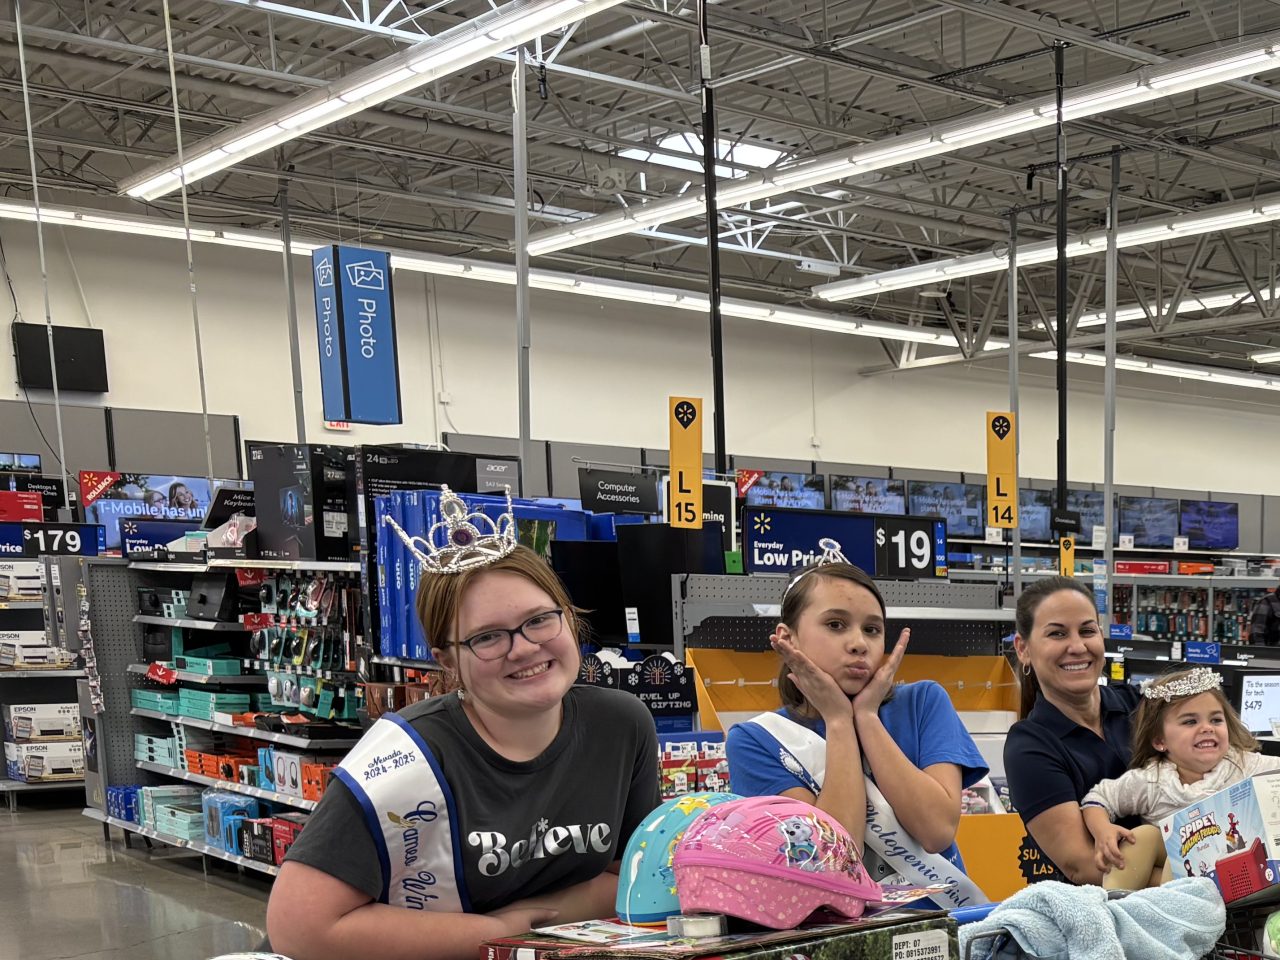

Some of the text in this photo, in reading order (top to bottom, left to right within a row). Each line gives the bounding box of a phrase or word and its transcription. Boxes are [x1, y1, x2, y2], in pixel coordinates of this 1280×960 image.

[322, 297, 332, 357] Photo
[358, 298, 377, 359] Photo
[366, 453, 379, 464] 24
[486, 463, 508, 473] acer
[86, 475, 114, 501] ROLLBACK
[598, 480, 636, 493] Computer
[678, 470, 691, 494] L
[995, 477, 1008, 497] L
[597, 491, 640, 504] Accessories
[98, 502, 186, 518] T-Mobile has
[675, 502, 697, 523] 15
[992, 505, 1014, 524] 14
[23, 530, 82, 552] $179
[753, 540, 784, 551] Everyday
[875, 526, 932, 570] $19
[753, 549, 789, 567] Low
[633, 692, 681, 702] LEVEL UP
[1245, 689, 1265, 697] for tech
[14, 705, 37, 713] EPSON
[651, 700, 692, 709] GIFTING
[1244, 700, 1263, 711] $479
[26, 745, 48, 753] EPSON
[363, 751, 417, 782] 2024-2025
[367, 750, 403, 769] Nevada
[1180, 812, 1216, 843] SPIDEY
[467, 817, 612, 878] Believe
[943, 873, 971, 909] Girl
[894, 940, 921, 951] DEPT: 07
[895, 951, 905, 960] PO:
